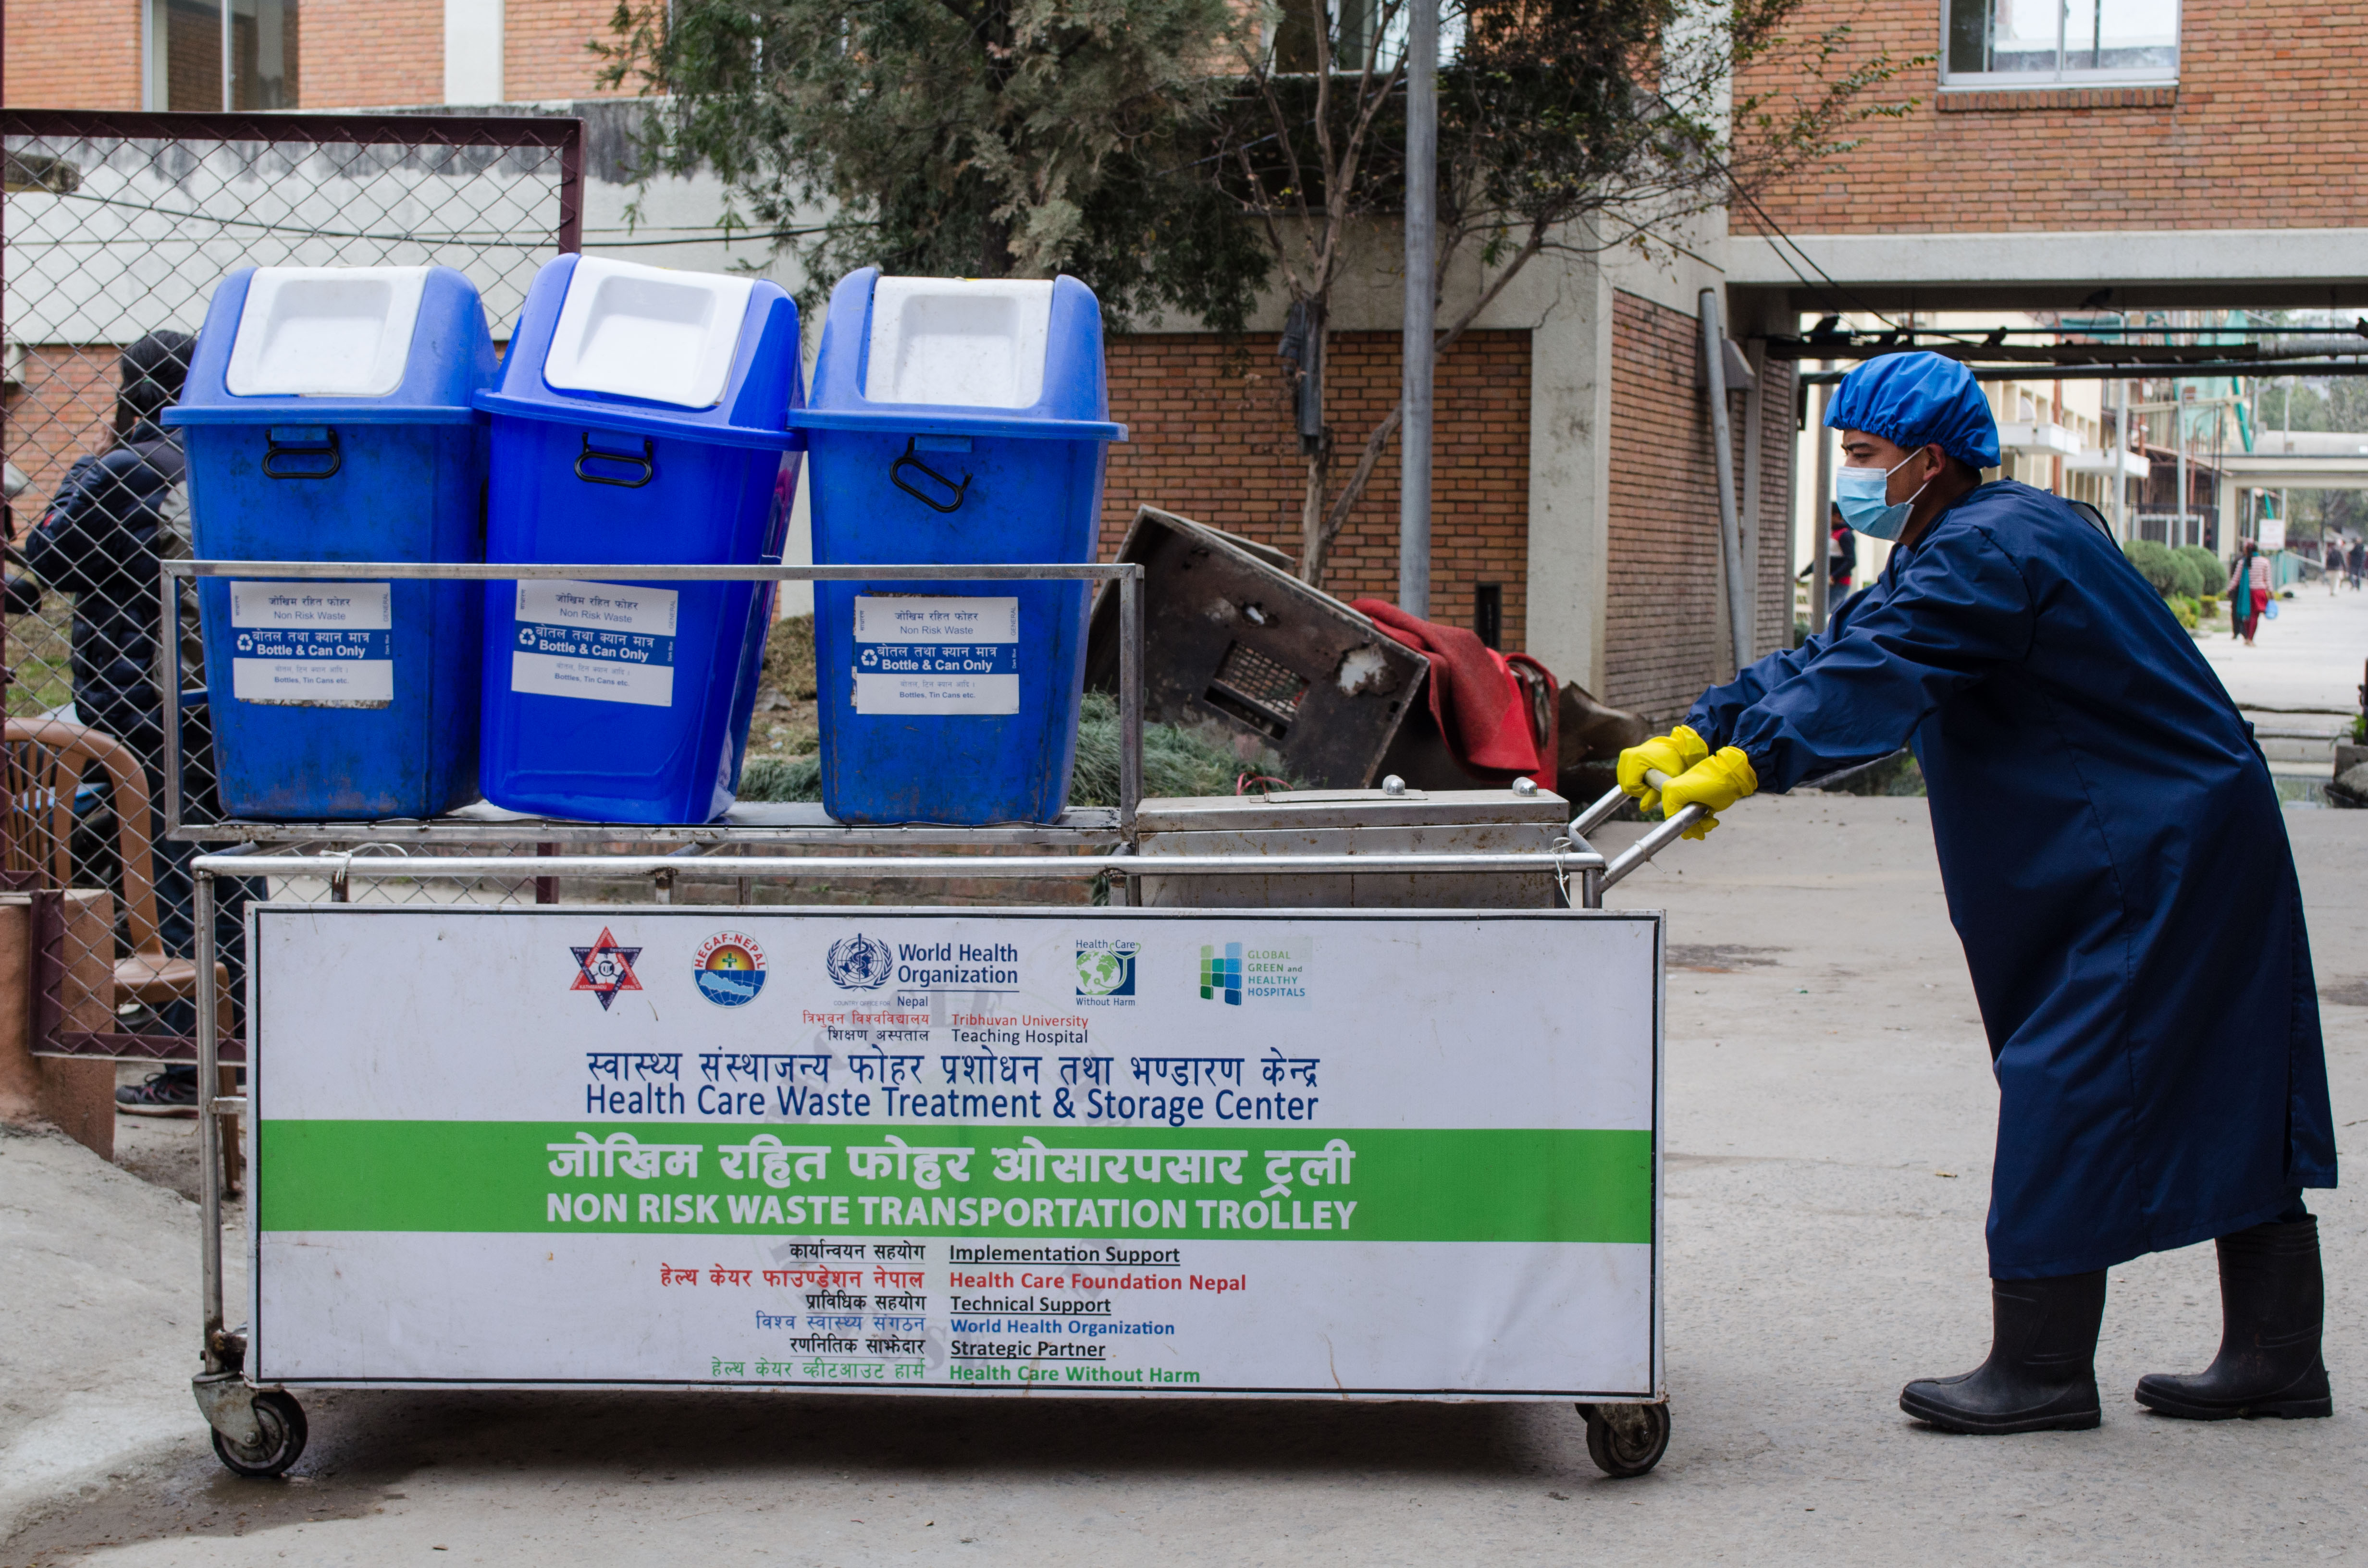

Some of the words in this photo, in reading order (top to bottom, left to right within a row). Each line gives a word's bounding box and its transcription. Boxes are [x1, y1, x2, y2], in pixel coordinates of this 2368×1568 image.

[560, 609, 578, 618] Non
[581, 610, 601, 620] Risk
[604, 612, 632, 623] Waste
[895, 611, 924, 621] जोखिम
[929, 611, 950, 621] रहित
[955, 611, 979, 621] फोहर
[288, 632, 309, 642] तथा
[573, 630, 594, 642] तथा
[900, 626, 918, 634] Non
[922, 626, 941, 634] Risk
[257, 645, 292, 655] Bottle
[296, 645, 305, 655] &
[308, 645, 333, 656] Can
[337, 645, 365, 659] Only
[540, 640, 575, 653] Bottle
[579, 645, 588, 654] &
[592, 645, 616, 657] Can
[620, 648, 648, 662] Only
[914, 647, 936, 657] तथा
[882, 660, 919, 670] Bottle
[922, 660, 931, 670] &
[935, 660, 960, 670] Can
[963, 660, 992, 673] Only
[694, 933, 765, 969] HECAF-NEPAL
[899, 943, 951, 961] World
[960, 943, 1018, 962] Health
[1076, 940, 1108, 949] Health
[1115, 940, 1135, 949] Care
[1247, 950, 1291, 959] GLOBAL
[1247, 963, 1283, 972] GREEN
[898, 965, 1018, 988] Organization
[1248, 976, 1298, 985] HEALTHY
[1247, 988, 1305, 997] HOSPITALS
[897, 996, 928, 1009] Nepal
[1076, 998, 1110, 1006] Without
[803, 1010, 845, 1027] त्रिभुवन
[852, 1010, 930, 1025] विश्वविद्यालय
[952, 1014, 1017, 1027] Tribhuvan
[1022, 1014, 1088, 1029] University
[828, 1026, 868, 1041] शिक्षण
[876, 1030, 930, 1041] अस्पताल
[952, 1029, 1020, 1045] Teaching
[1025, 1029, 1088, 1046] Hospital
[587, 1053, 683, 1083] स्वास्थ्य
[700, 1046, 832, 1084] संस्थाजन्य
[848, 1043, 925, 1086] फोहर
[941, 1045, 1042, 1086] प्रशोधन
[1059, 1056, 1114, 1086] तथा
[1131, 1056, 1244, 1087] भण्डारण
[1261, 1047, 1320, 1088] केन्द्र
[587, 1083, 685, 1115] Health
[698, 1085, 765, 1116] Care
[777, 1086, 870, 1117] Waste
[882, 1087, 1041, 1118] Treatment
[1052, 1088, 1075, 1119] &
[1087, 1088, 1203, 1127] Storage
[1215, 1089, 1319, 1121] Center
[547, 1132, 703, 1180] जोखिम
[718, 1134, 831, 1188] रहित
[847, 1135, 974, 1190] फोहर
[991, 1136, 1248, 1185] ओसारपसार
[1260, 1139, 1356, 1198] ट्रली
[547, 1193, 634, 1224] NON
[639, 1193, 719, 1224] RISK
[727, 1195, 850, 1225] WASTE
[858, 1196, 1186, 1229] TRANSPORTATION
[1196, 1200, 1357, 1230] TROLLEY
[789, 1240, 866, 1260] कार्यान्वयन
[873, 1240, 925, 1261] सहयोग
[950, 1245, 1099, 1264] Implementation
[1106, 1247, 1180, 1265] Support
[661, 1262, 699, 1287] हेल्थ
[710, 1263, 752, 1287] केयर
[763, 1264, 863, 1288] फाउण्डेशन
[873, 1265, 925, 1289] नेपाल
[950, 1272, 1014, 1288] Health
[1021, 1273, 1065, 1289] Care
[1072, 1274, 1183, 1290] Foundation
[1190, 1275, 1246, 1294] Nepal
[806, 1290, 867, 1310] प्राविधिक
[875, 1290, 926, 1311] सहयोग
[951, 1296, 1035, 1311] Technical
[1040, 1297, 1111, 1315] Support
[756, 1310, 797, 1330] विश्व
[807, 1315, 863, 1331] स्वास्थ्य
[874, 1314, 926, 1332] संगठन
[951, 1318, 1002, 1334] World
[1008, 1319, 1062, 1334] Health
[1068, 1320, 1175, 1337] Organization
[951, 1340, 1032, 1359] Strategic
[1038, 1342, 1106, 1358] Partner
[712, 1356, 746, 1377] हेल्थ
[755, 1357, 793, 1377] केयर
[895, 1358, 926, 1379] हार्म
[950, 1365, 1011, 1381] Health
[1017, 1366, 1059, 1382] Care
[1066, 1366, 1144, 1383] Without
[1149, 1367, 1200, 1383] Harm
